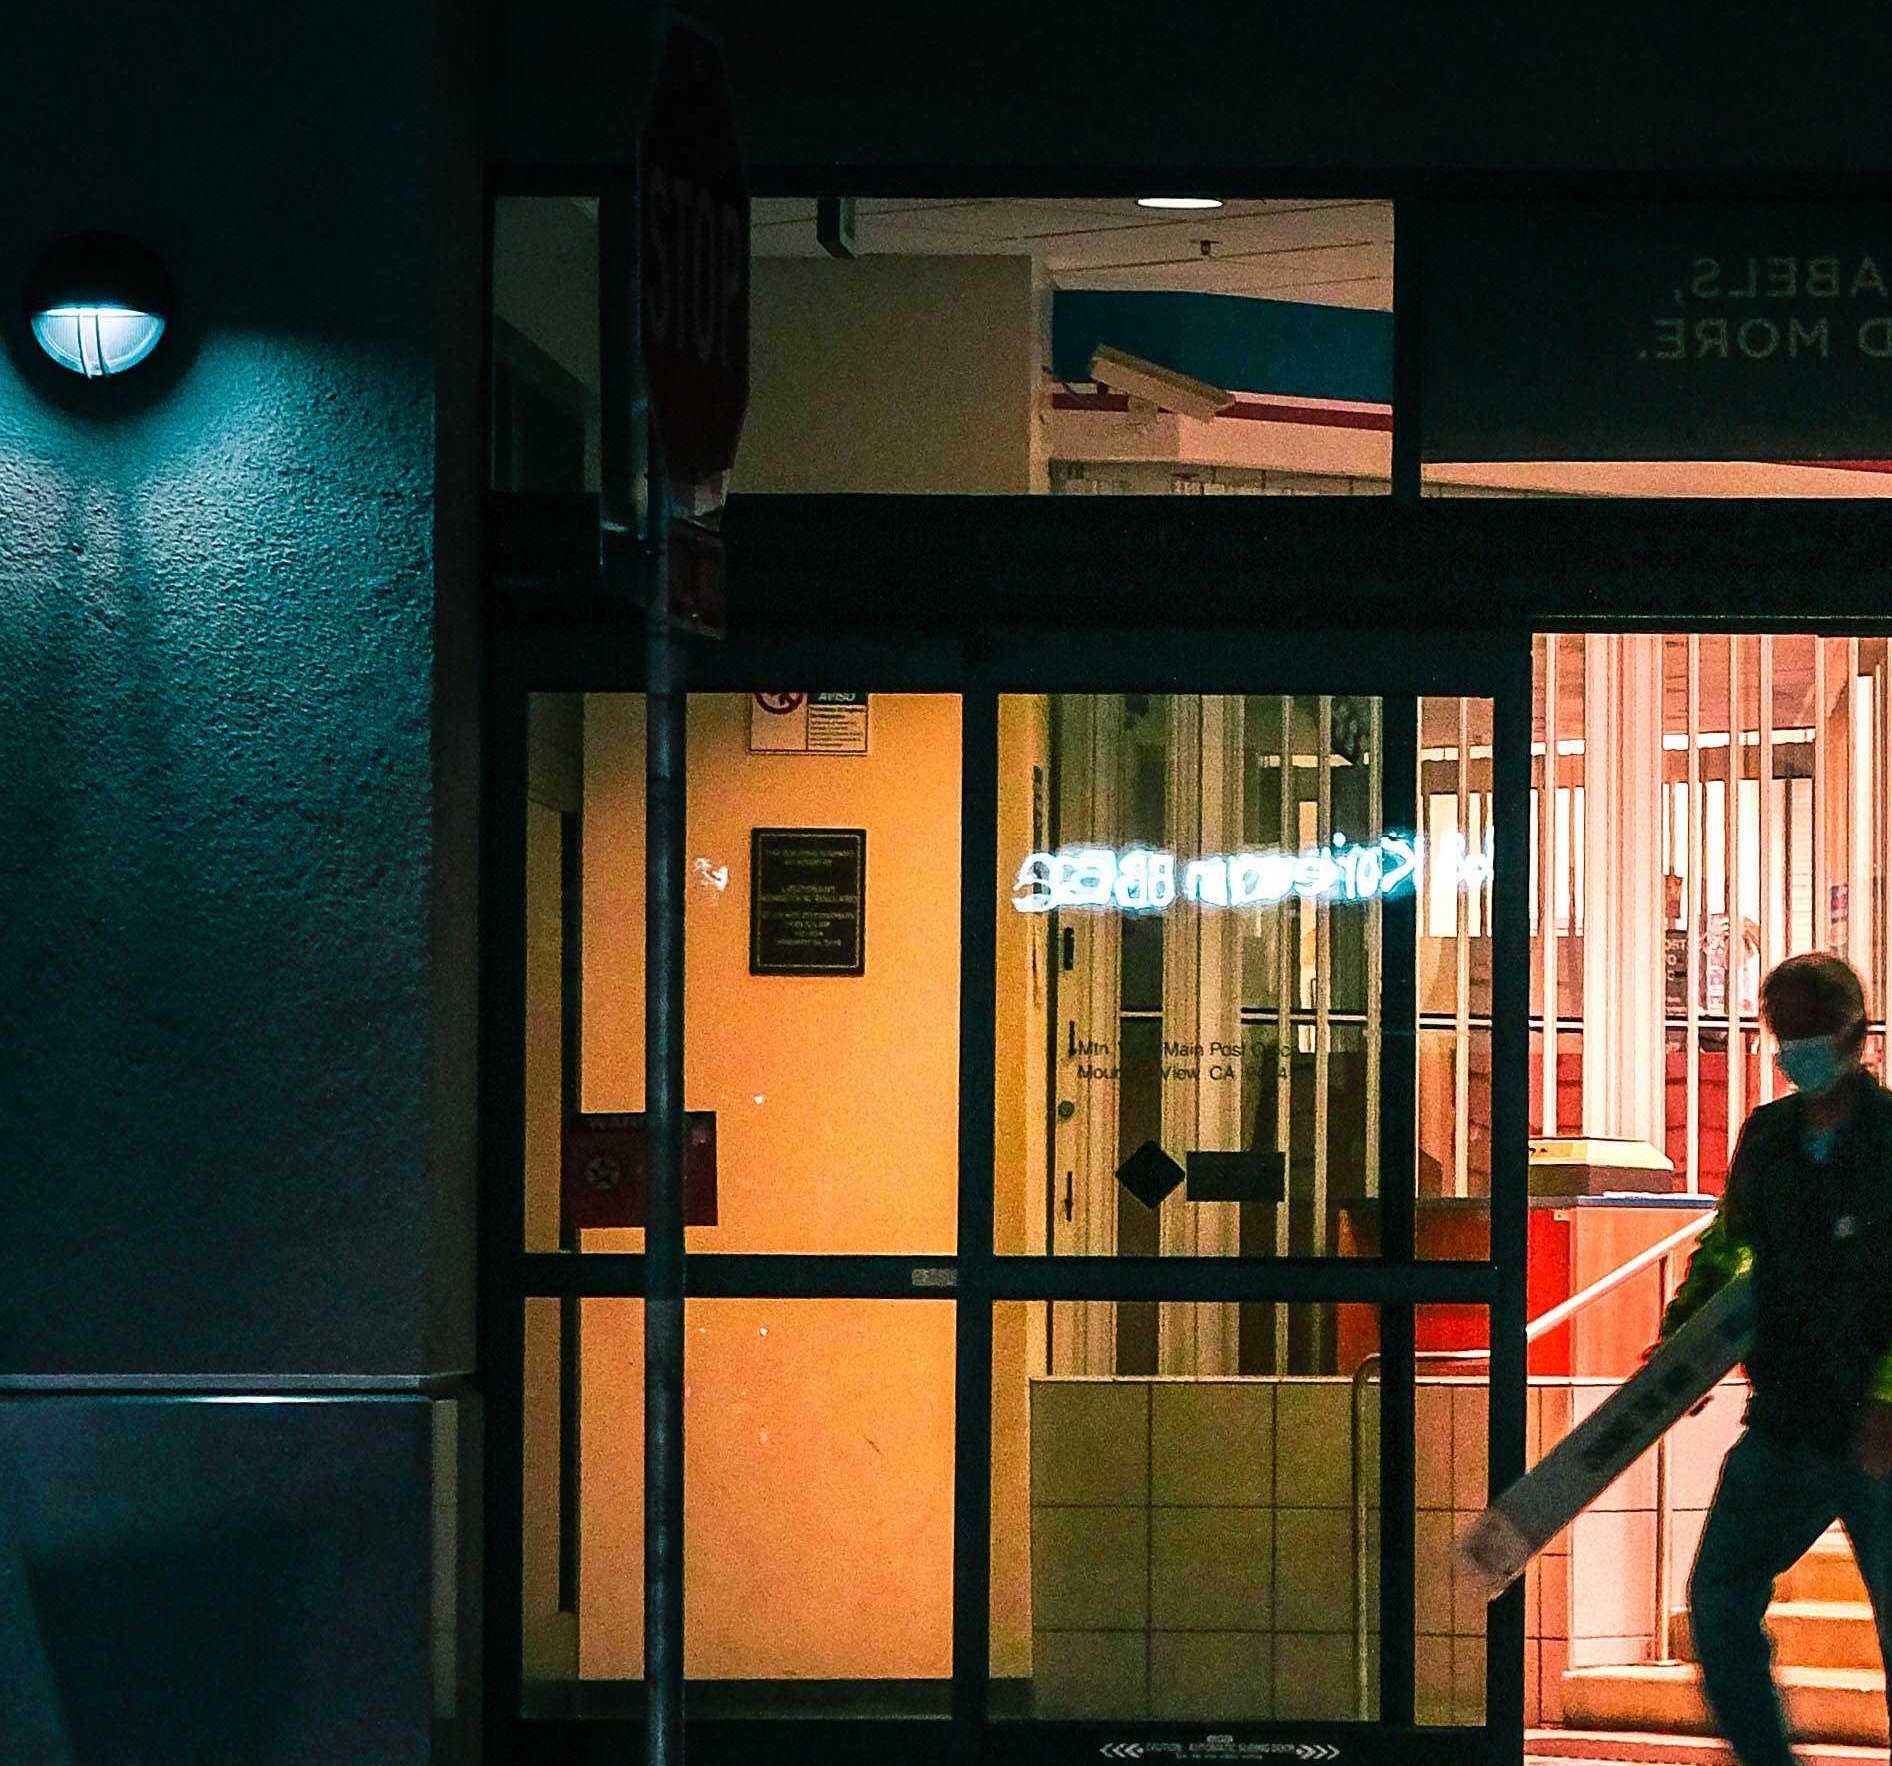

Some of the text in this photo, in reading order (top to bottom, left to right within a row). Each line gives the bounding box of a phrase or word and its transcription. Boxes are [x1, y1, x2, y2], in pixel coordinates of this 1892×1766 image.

[645, 162, 744, 372] STOP
[1163, 1040, 1204, 1058] Main
[1160, 1064, 1200, 1081] View
[1208, 1064, 1235, 1082] CA
